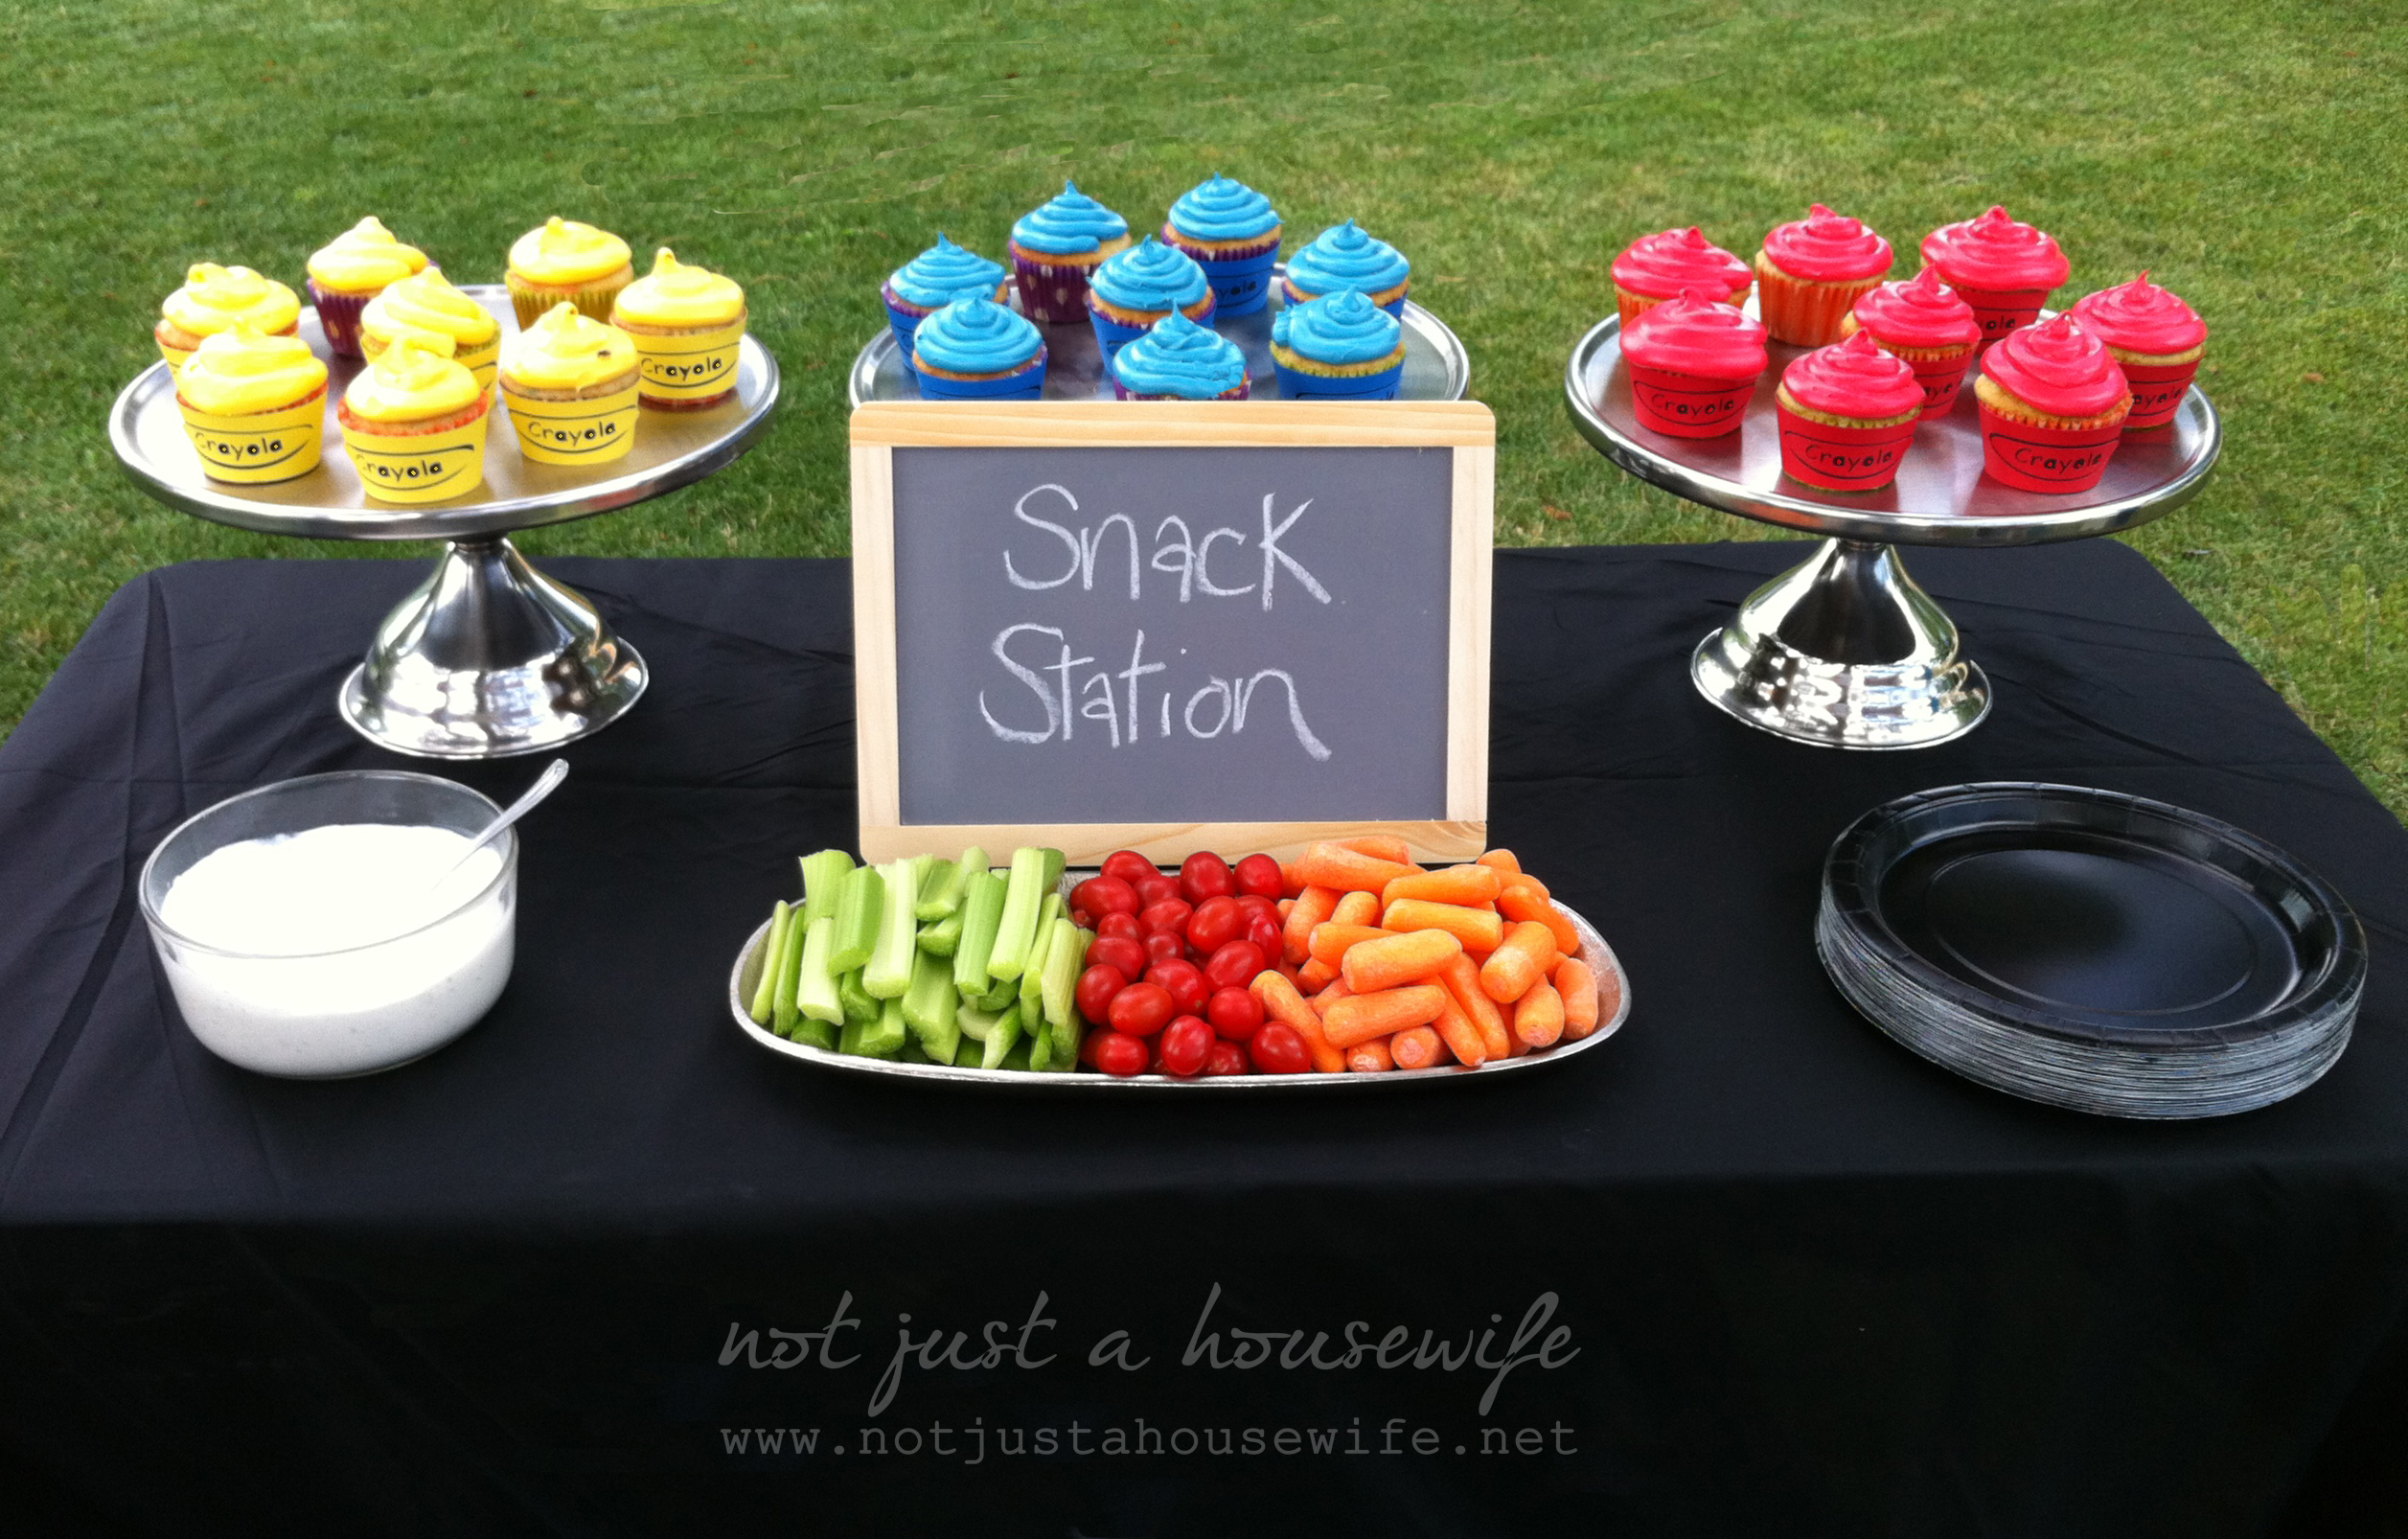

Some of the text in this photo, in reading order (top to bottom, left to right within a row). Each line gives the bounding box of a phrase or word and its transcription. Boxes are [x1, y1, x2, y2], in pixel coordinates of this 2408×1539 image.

[640, 356, 722, 381] Crayola
[1651, 393, 1734, 419] Crayola
[195, 431, 284, 461] Crayola
[528, 421, 616, 448] Crayola
[1805, 444, 1893, 472] Crayola
[2014, 448, 2102, 475] Crayola
[1003, 483, 1332, 612] Snack
[979, 622, 1333, 762] Station
